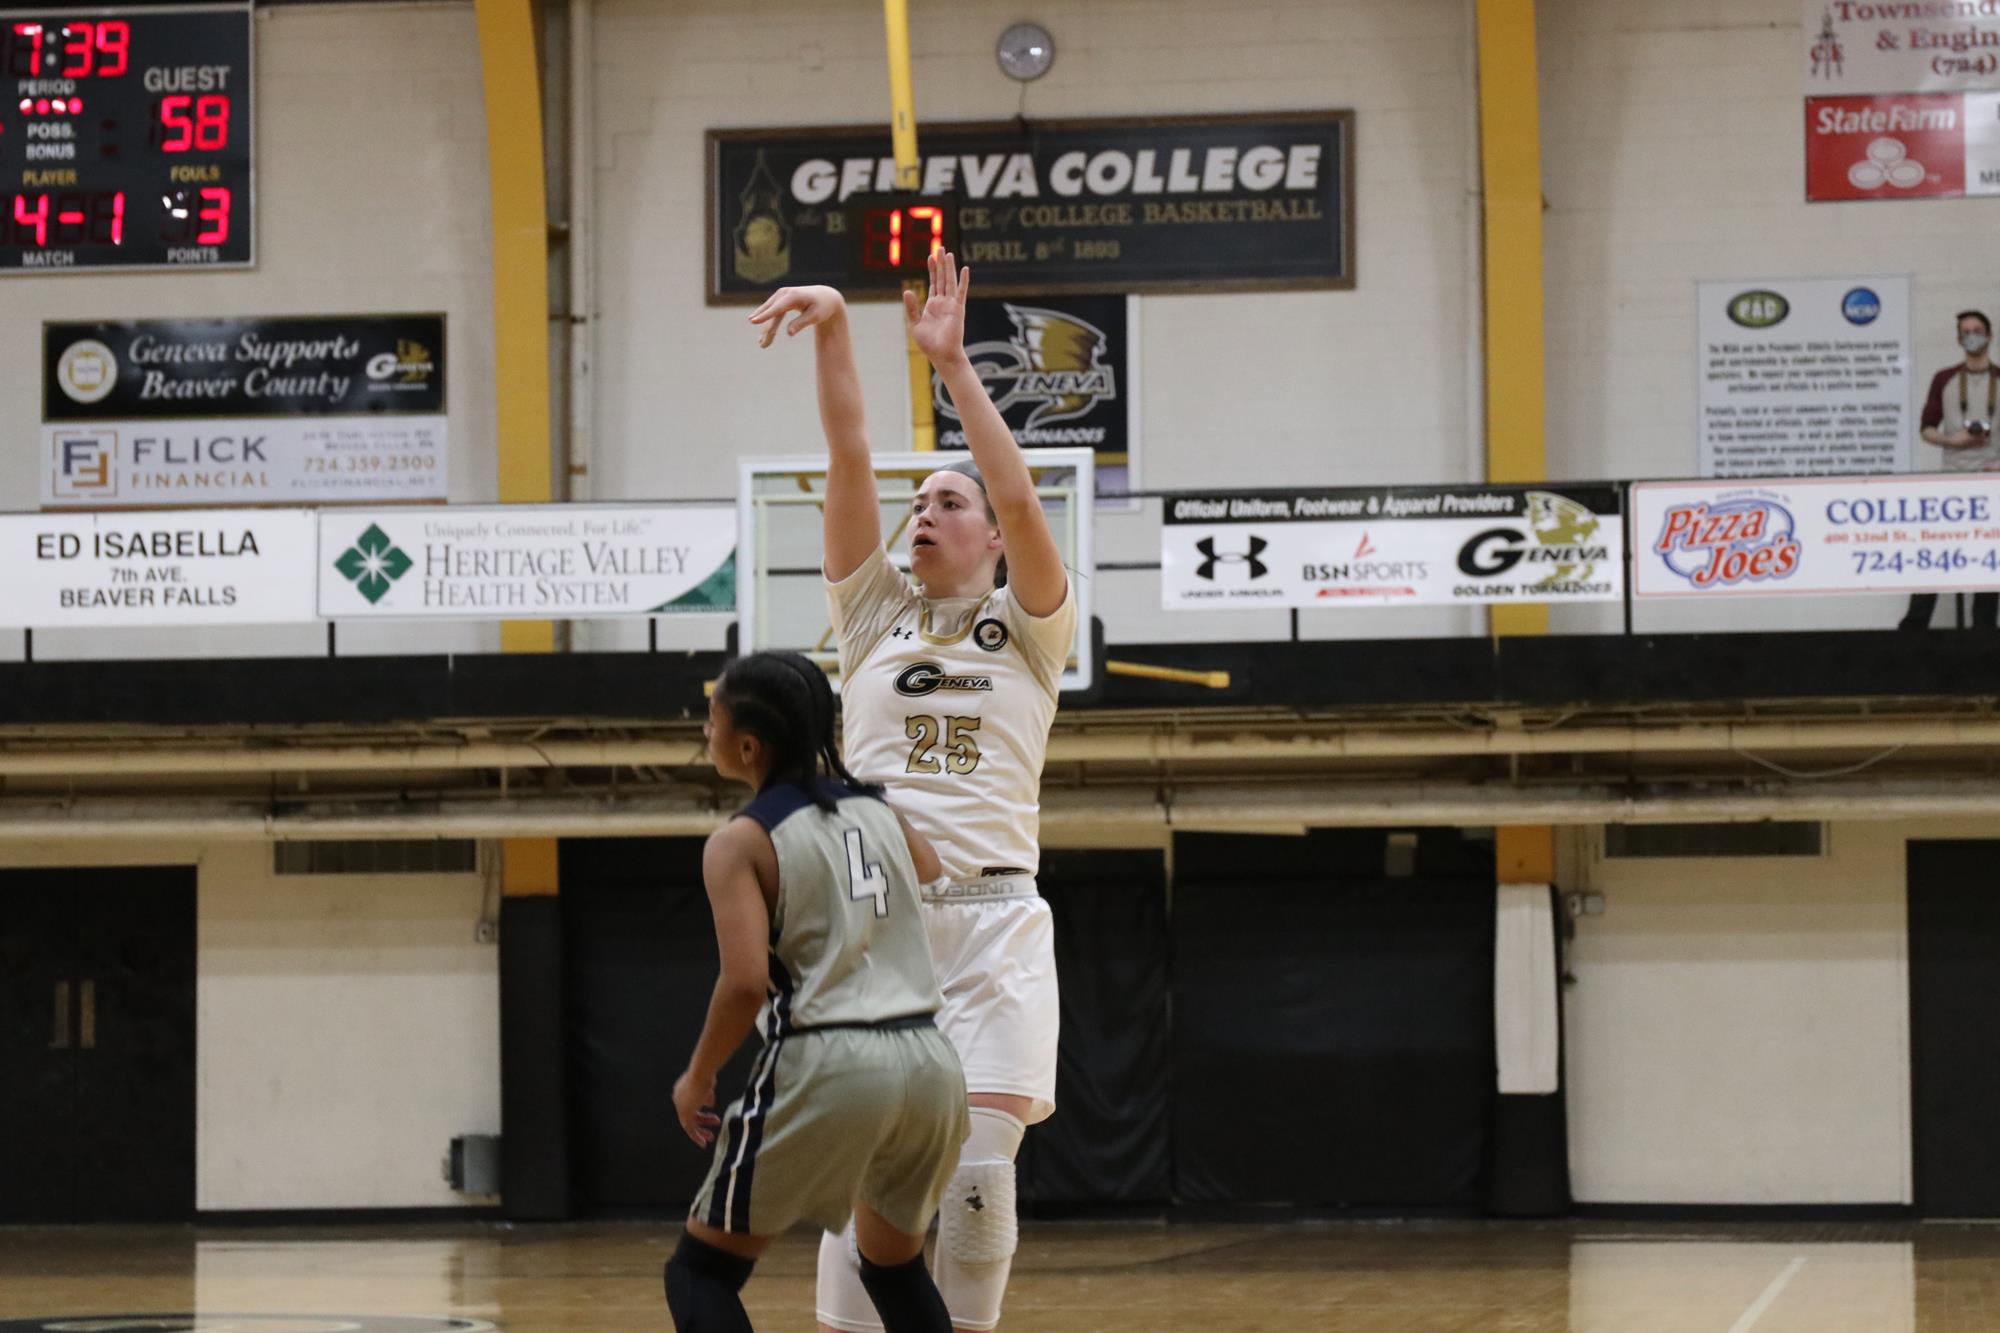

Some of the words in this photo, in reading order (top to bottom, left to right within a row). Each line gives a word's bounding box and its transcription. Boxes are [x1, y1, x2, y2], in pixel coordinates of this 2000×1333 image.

[13, 21, 129, 78] 7:39
[1876, 29, 1899, 50] &
[18, 79, 76, 95] PERIOD
[144, 66, 230, 92] GUEST
[161, 95, 230, 152] 58
[26, 143, 75, 159] BONUS
[23, 169, 77, 185] PLAYER
[170, 165, 220, 182] FOULS
[1049, 144, 1322, 197] COLLEGE
[1019, 202, 1133, 228] COLLEGE
[1143, 199, 1323, 226] BASKETBALL
[889, 205, 943, 266] 17
[22, 251, 74, 267] MATCH
[167, 247, 219, 263] POINTS
[128, 335, 227, 364] Geneva
[235, 332, 360, 370] Supports
[138, 370, 237, 399] Beaver
[244, 367, 349, 403] County
[133, 436, 268, 465] FLICK
[132, 471, 269, 489] FINANCIAL
[1174, 498, 1228, 519] Official
[1229, 498, 1291, 519] Uniform,
[1293, 497, 1364, 516] Footwear
[1366, 495, 1380, 515] &
[1381, 494, 1441, 517] Apparel
[1442, 493, 1515, 513] Providers
[1826, 496, 1990, 525] COLLEGE
[424, 522, 489, 541] Uniquely
[583, 519, 608, 535] For
[1658, 505, 1767, 551] Pizza
[1920, 528, 1969, 540] Beaver
[37, 533, 81, 559] ED
[94, 530, 260, 559] ISABELLA
[425, 543, 576, 577] HERITAGE
[582, 541, 691, 575] VALLEY
[1456, 527, 1609, 578] GENEVA
[110, 567, 138, 583] 7th
[145, 566, 187, 583] AVE.
[1302, 564, 1349, 581] BSN
[1353, 561, 1428, 581] SPORTS
[1694, 536, 1799, 584] Joe's
[1851, 548, 2000, 575] 724-846-4
[60, 587, 154, 608] BEAVER
[163, 586, 237, 607] FALLS
[424, 580, 524, 607] HEALTH
[534, 577, 629, 606] SYSTEM
[1453, 584, 1514, 597] GOLDEN
[1521, 581, 1612, 596] TORNADOES
[893, 662, 993, 697] GENEVA
[905, 714, 982, 775] 25
[843, 827, 889, 918] 4
